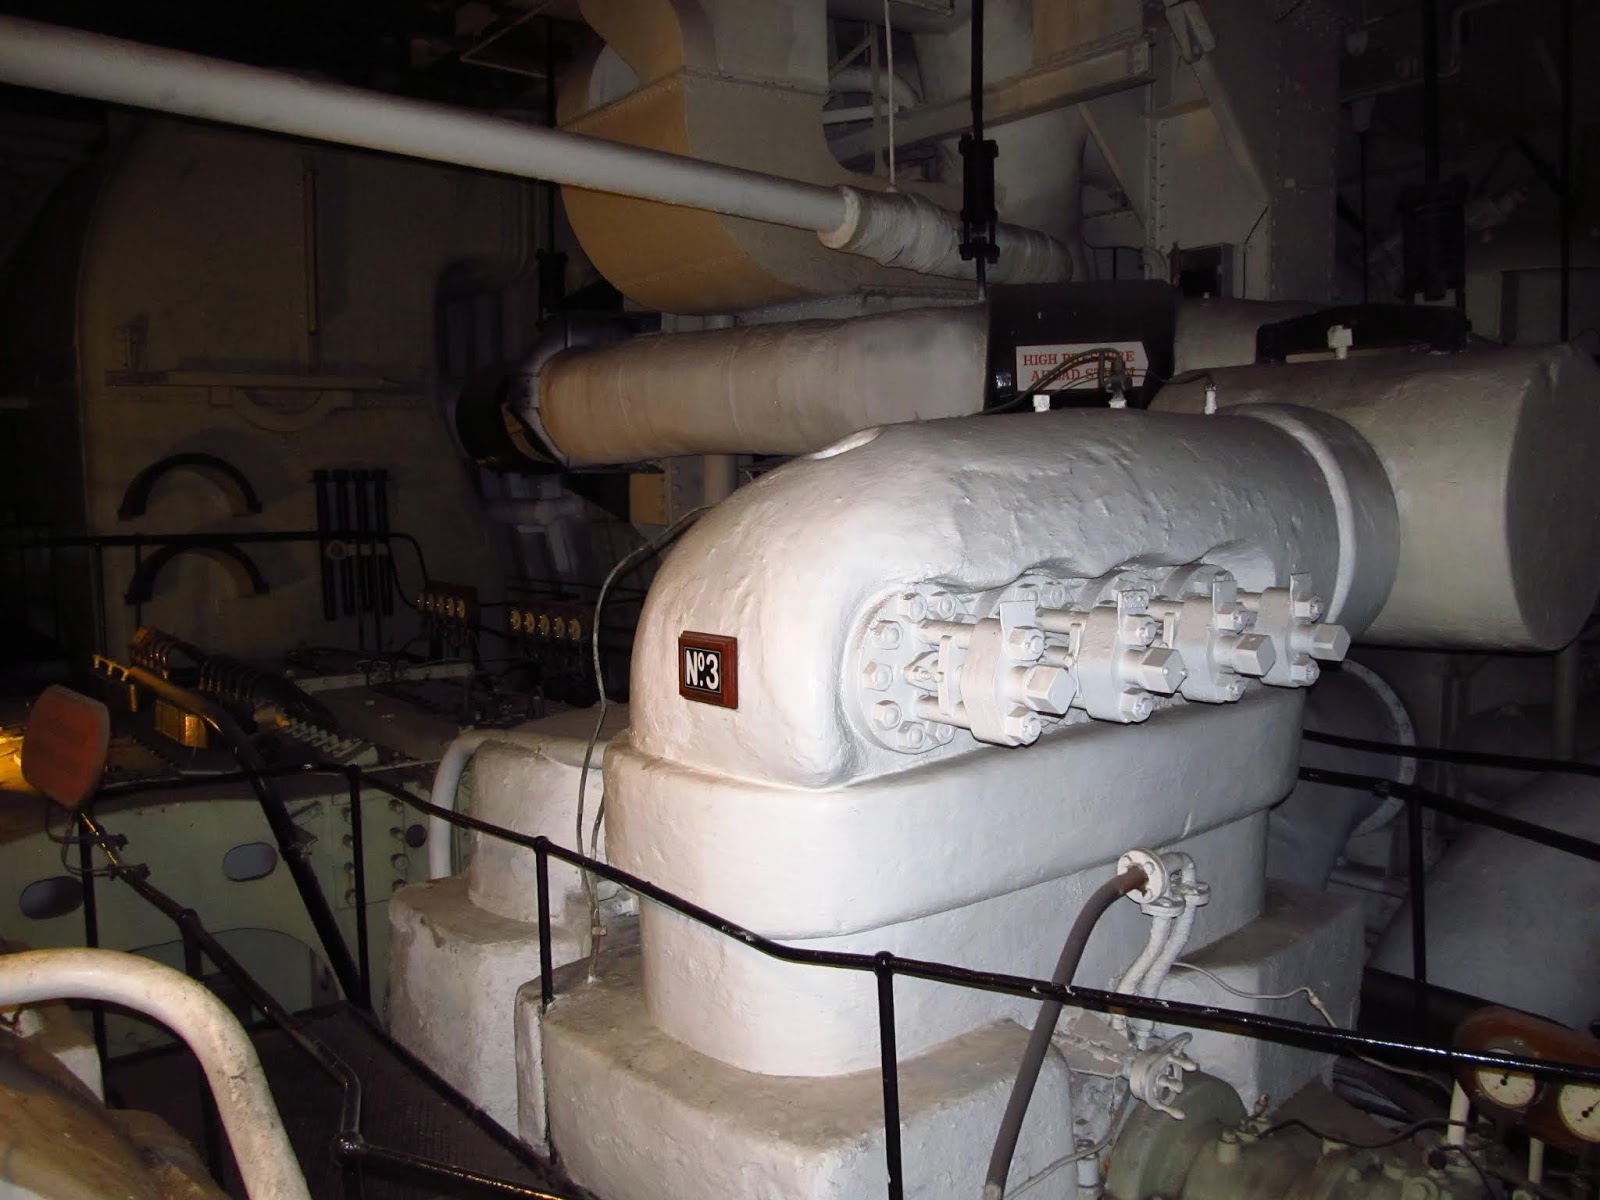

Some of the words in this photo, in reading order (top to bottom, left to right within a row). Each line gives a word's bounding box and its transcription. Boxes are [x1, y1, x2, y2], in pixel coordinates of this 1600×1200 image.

[1023, 354, 1058, 366] HIGH
[1031, 369, 1080, 381] AAD
[1086, 367, 1136, 379] STEM
